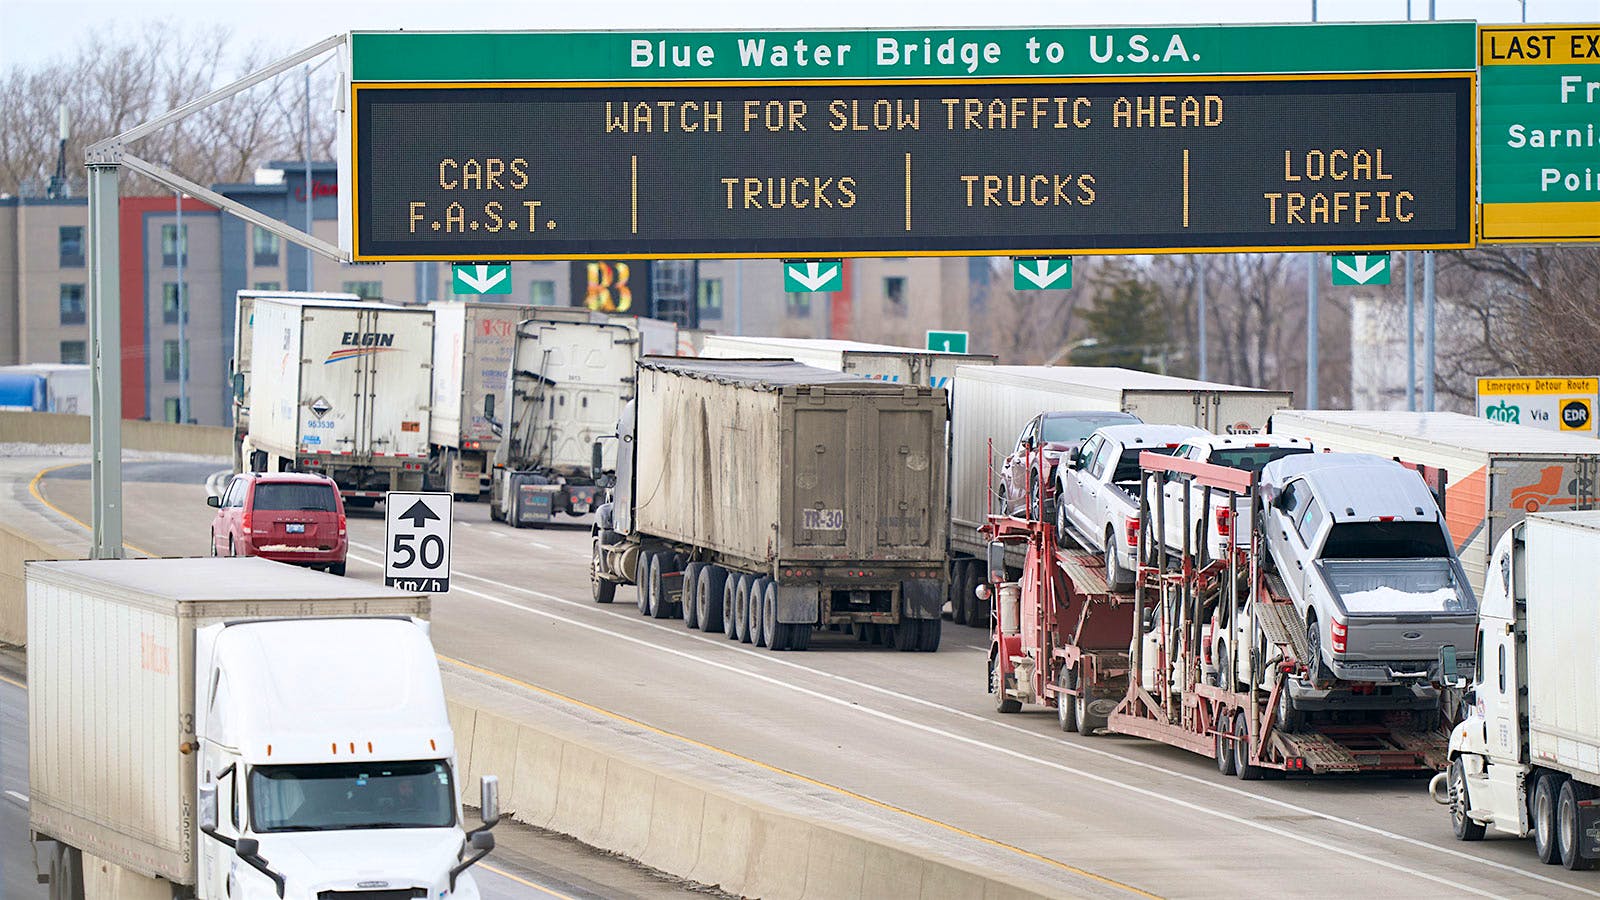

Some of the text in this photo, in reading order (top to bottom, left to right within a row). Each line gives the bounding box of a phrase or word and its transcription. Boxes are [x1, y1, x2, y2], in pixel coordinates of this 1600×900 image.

[632, 35, 1200, 73] Blue Water Bridge to U.S.A.
[1491, 36, 1555, 60] LAST
[606, 96, 1223, 132] WATCH FOR SLOW TRAFFIC AHEAD
[1507, 124, 1600, 148] Sarni
[439, 158, 528, 190] CARS
[1285, 149, 1393, 181] LOCAL
[1541, 168, 1600, 191] Poi
[721, 177, 856, 209] TRUCKS
[961, 175, 1096, 207] TRUCKS
[410, 201, 557, 233] F.A.S.T.
[1264, 191, 1414, 224] TRAFFIC
[341, 331, 395, 347] ELGIN
[1487, 380, 1590, 392] Emergency Detour Route
[1490, 409, 1587, 424] 402 Via EDR
[804, 511, 843, 529] TR-30
[392, 534, 444, 570] 50
[393, 578, 441, 592] km/h
